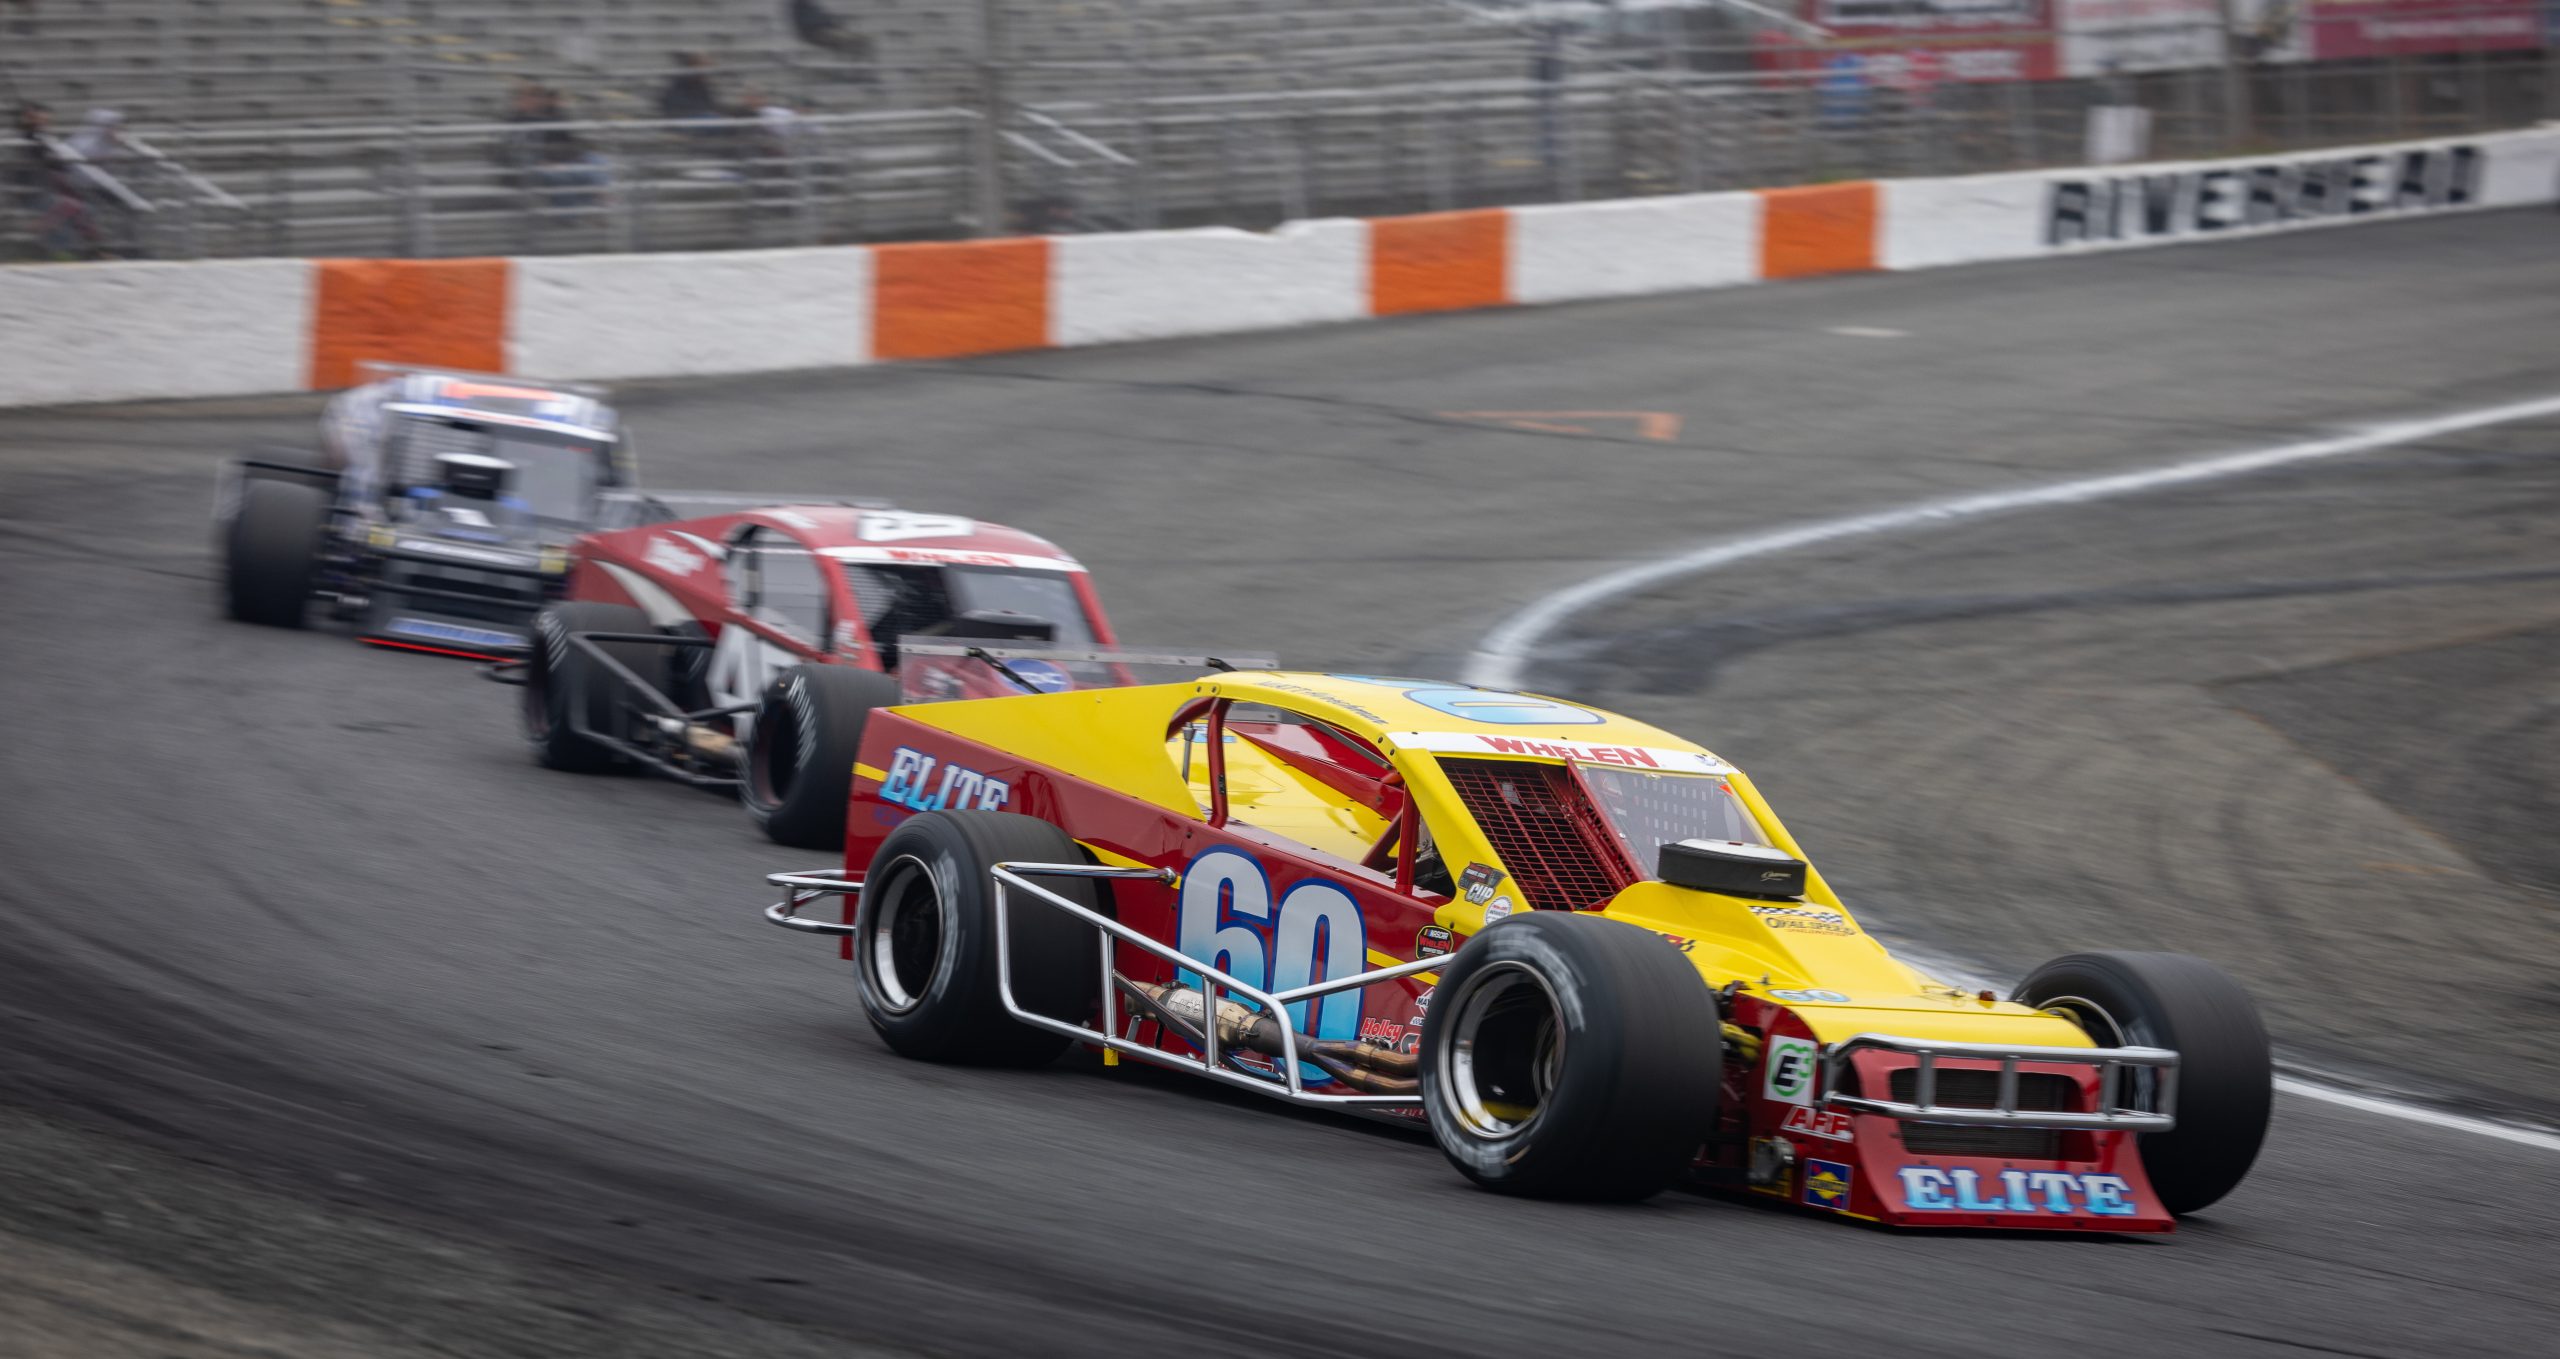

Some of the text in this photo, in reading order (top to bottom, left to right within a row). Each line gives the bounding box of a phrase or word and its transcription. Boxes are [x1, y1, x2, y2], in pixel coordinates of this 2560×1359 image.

[2046, 144, 2482, 247] RIVERHEAD
[1475, 734, 1661, 768] WHELEN
[879, 744, 1011, 812] ELITE
[1465, 882, 1496, 906] CUP
[1175, 843, 1367, 1088] 60
[1360, 1016, 1404, 1044] Holley
[1897, 1165, 2137, 1216] ELITE
